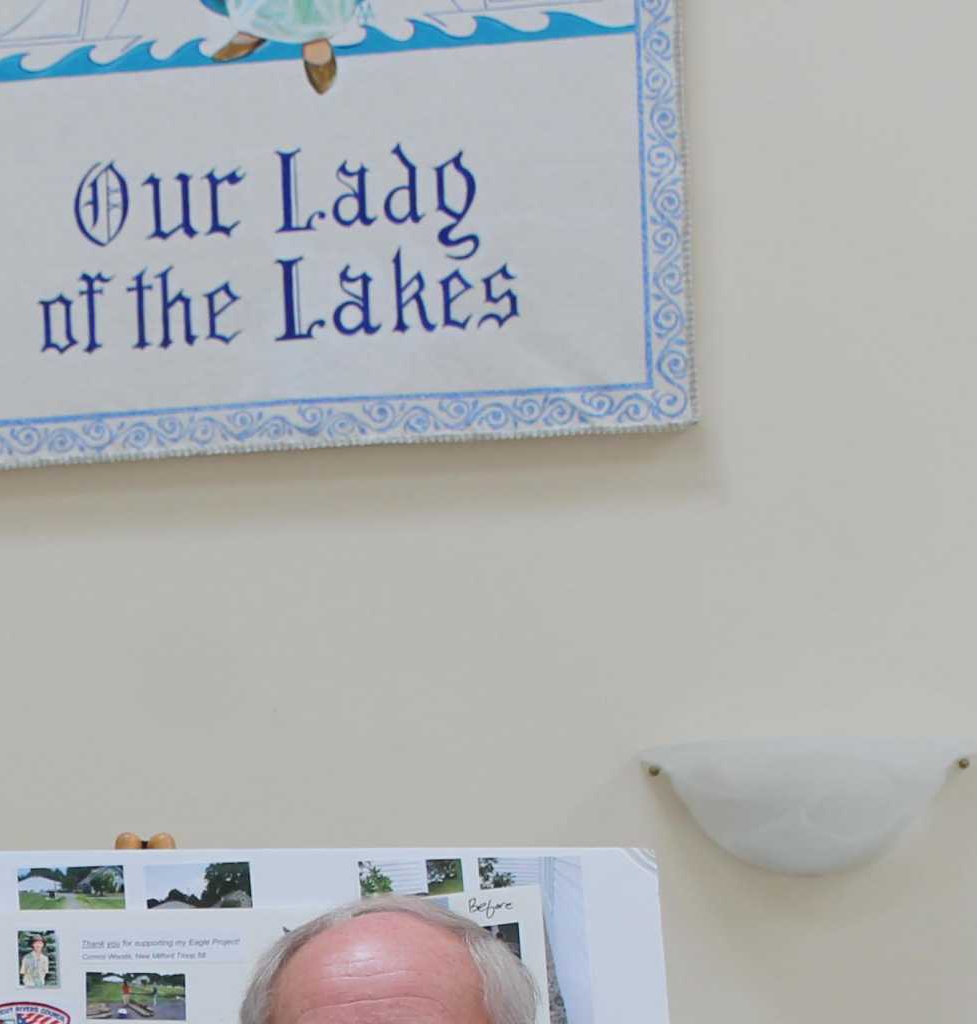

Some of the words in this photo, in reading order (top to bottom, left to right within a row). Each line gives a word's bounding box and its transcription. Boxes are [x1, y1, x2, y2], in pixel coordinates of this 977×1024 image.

[74, 161, 246, 248] Our
[274, 143, 478, 260] Lady
[38, 270, 111, 355] of
[127, 265, 242, 350] the
[274, 247, 521, 344] Lakes
[467, 897, 514, 919] Before
